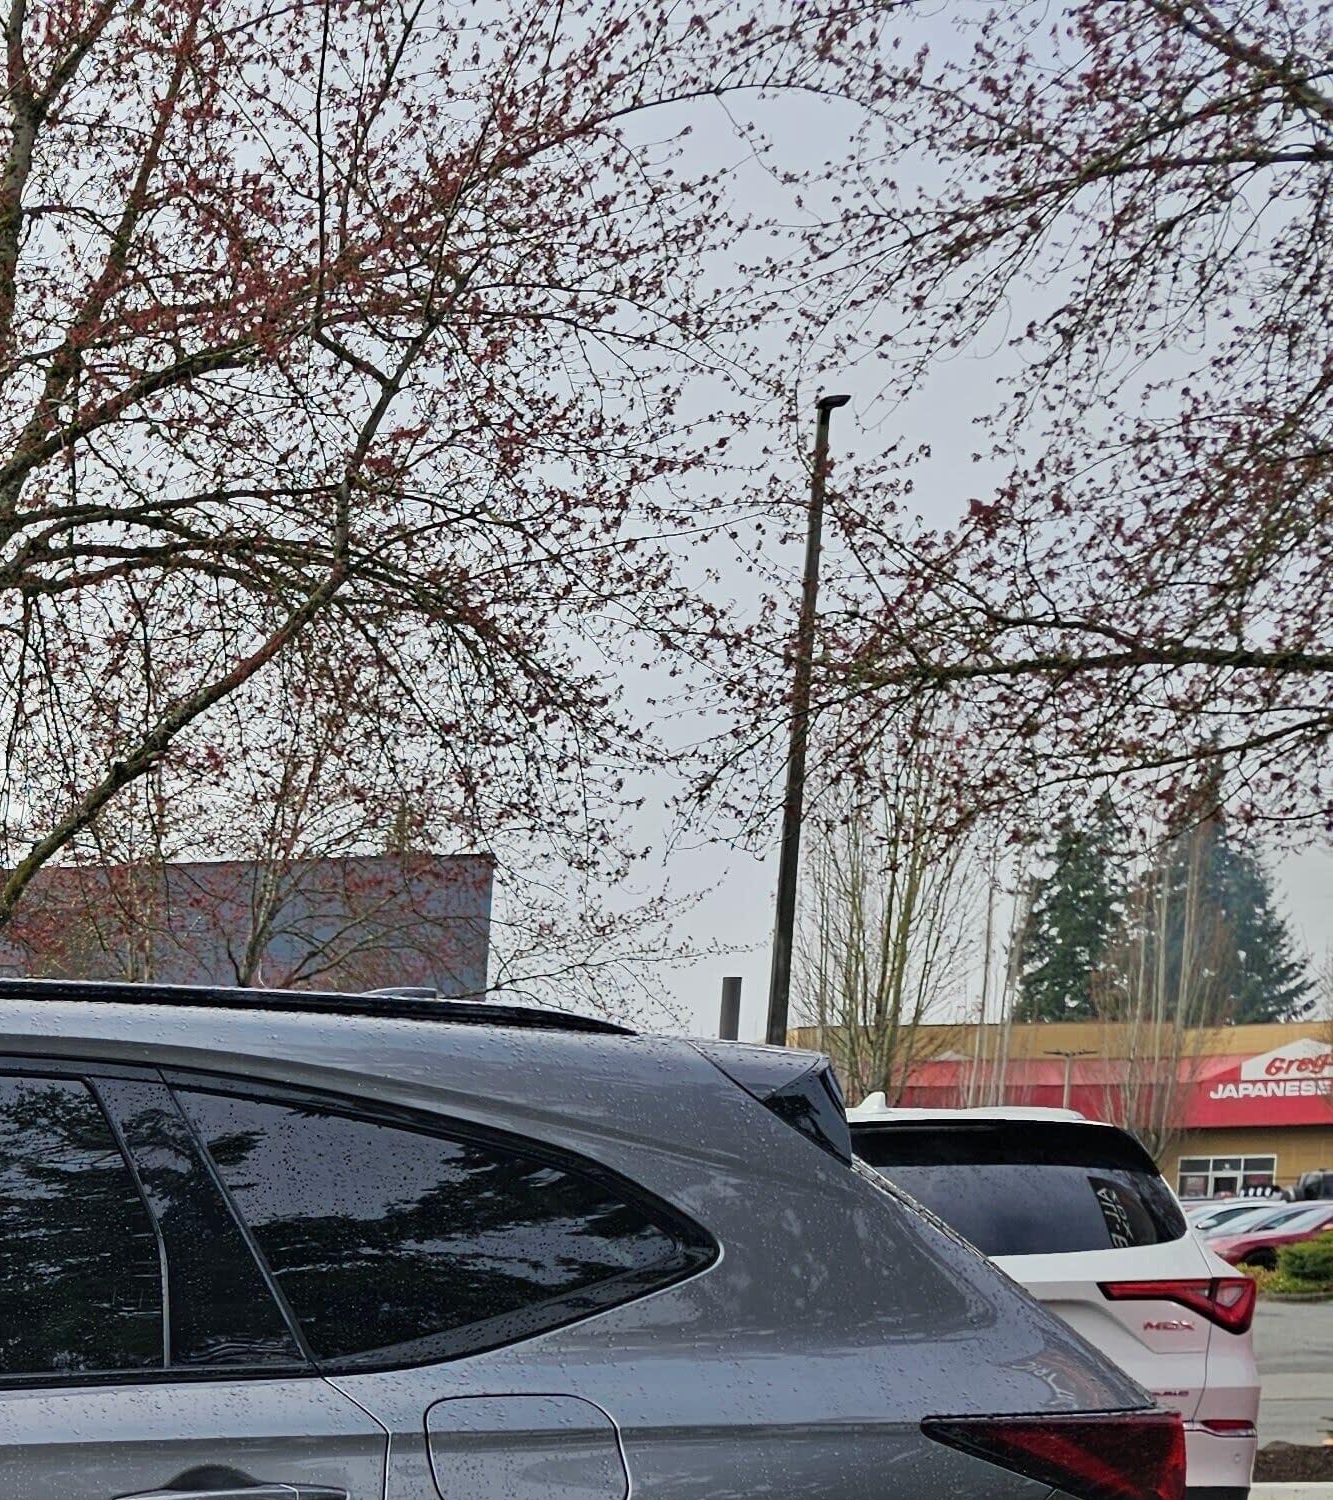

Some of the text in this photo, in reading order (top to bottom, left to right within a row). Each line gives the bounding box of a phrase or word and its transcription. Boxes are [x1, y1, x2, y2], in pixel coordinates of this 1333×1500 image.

[1265, 1054, 1333, 1077] Greg
[1210, 1081, 1332, 1099] JAPANESE
[1143, 1321, 1195, 1331] MDX
